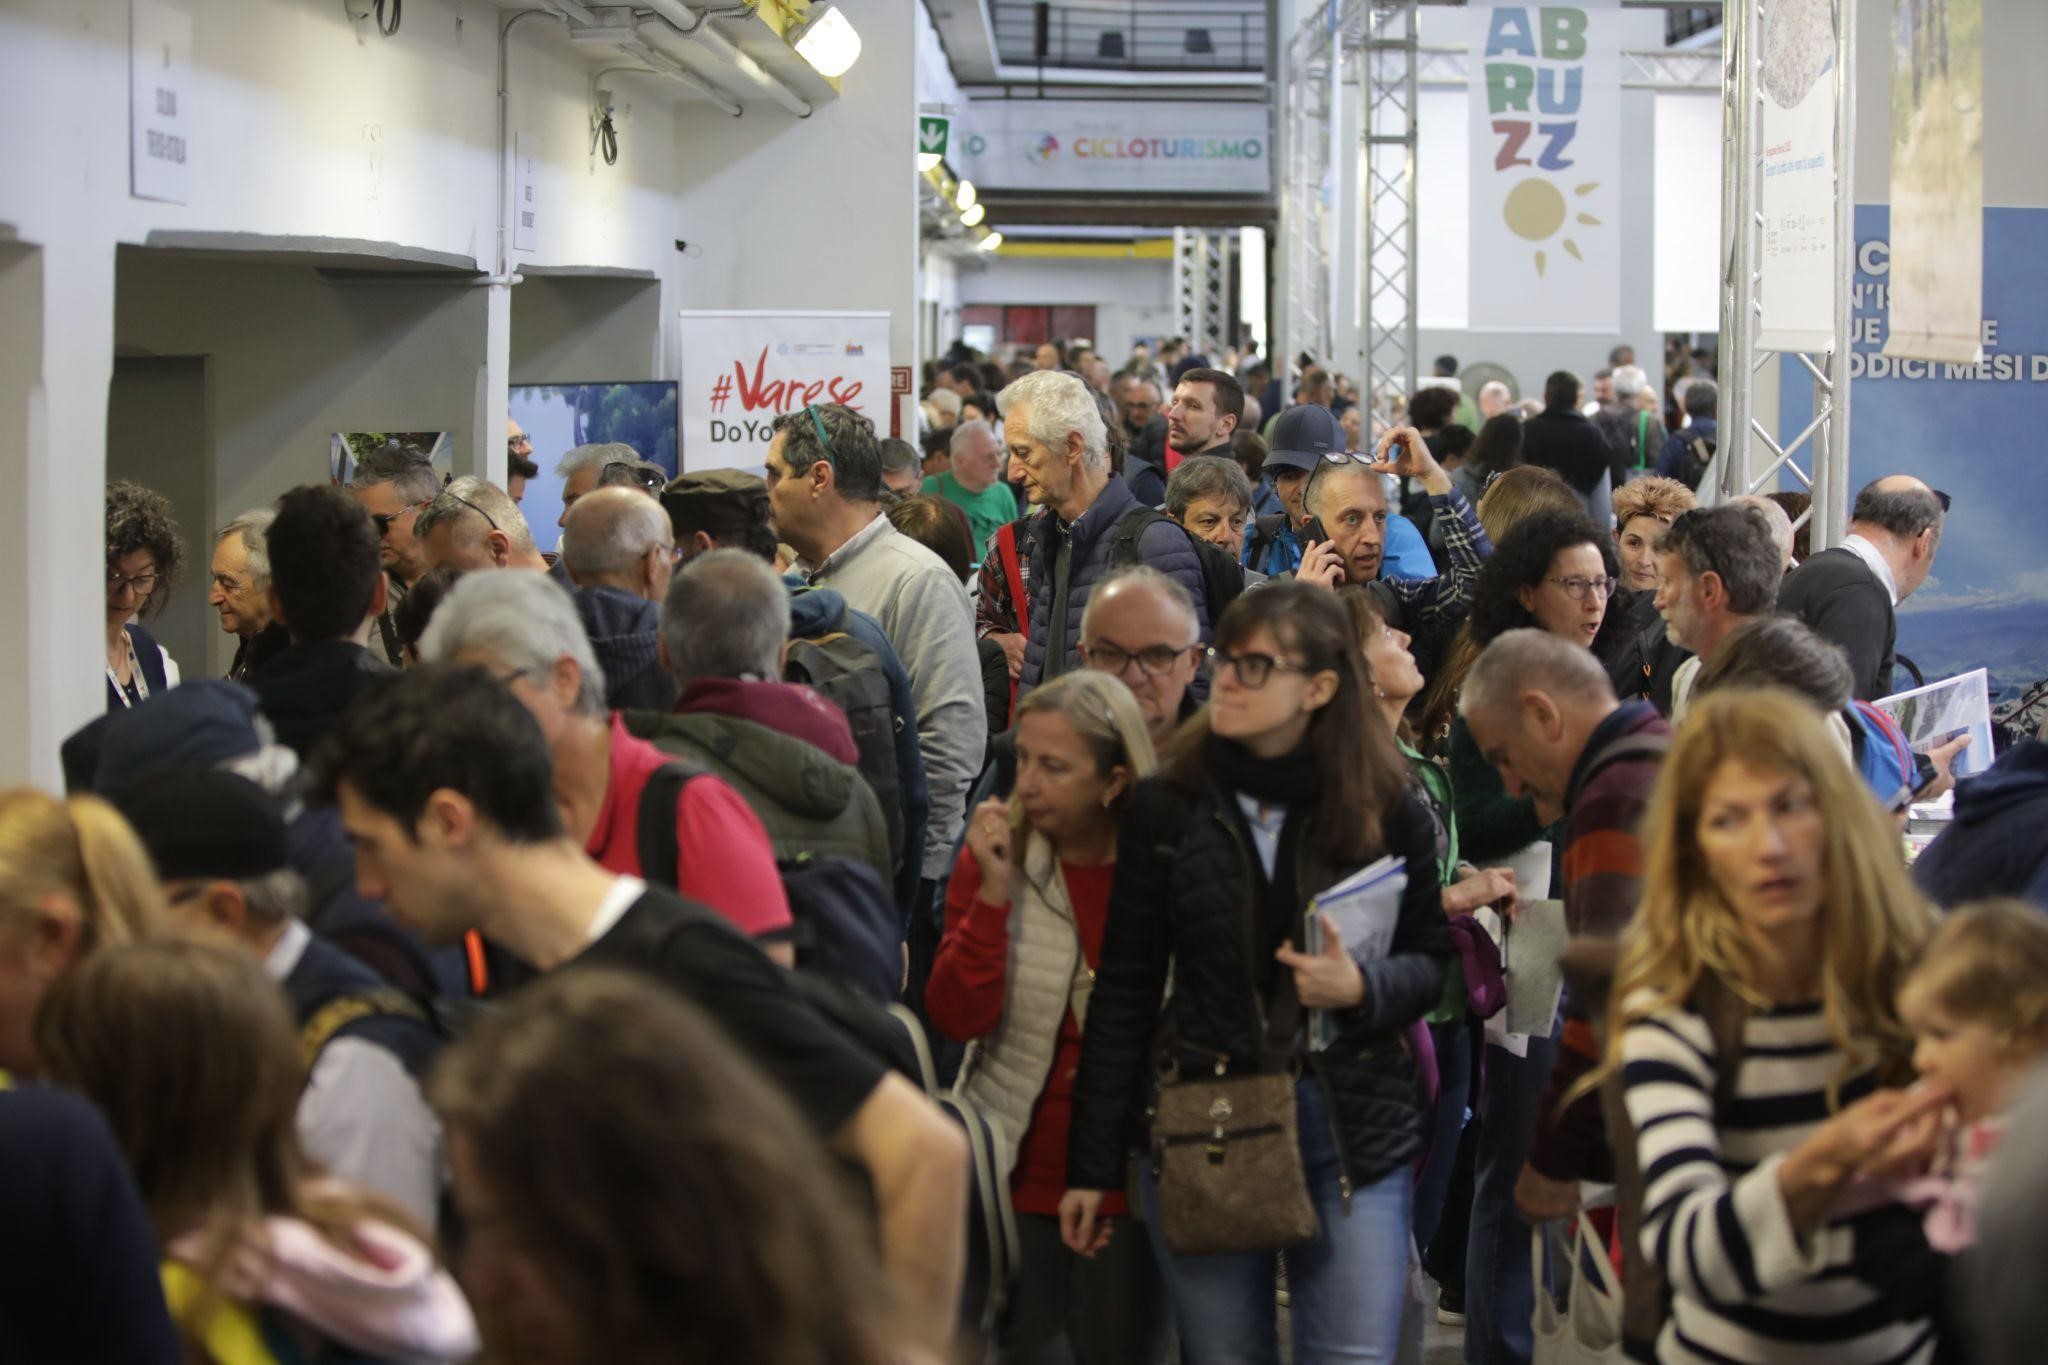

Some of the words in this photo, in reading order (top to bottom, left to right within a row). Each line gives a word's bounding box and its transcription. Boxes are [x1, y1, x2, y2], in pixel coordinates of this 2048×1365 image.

[1073, 135, 1262, 159] CICLOTURISMO
[710, 344, 864, 415] #Varese
[1944, 354, 2023, 381] MESI
